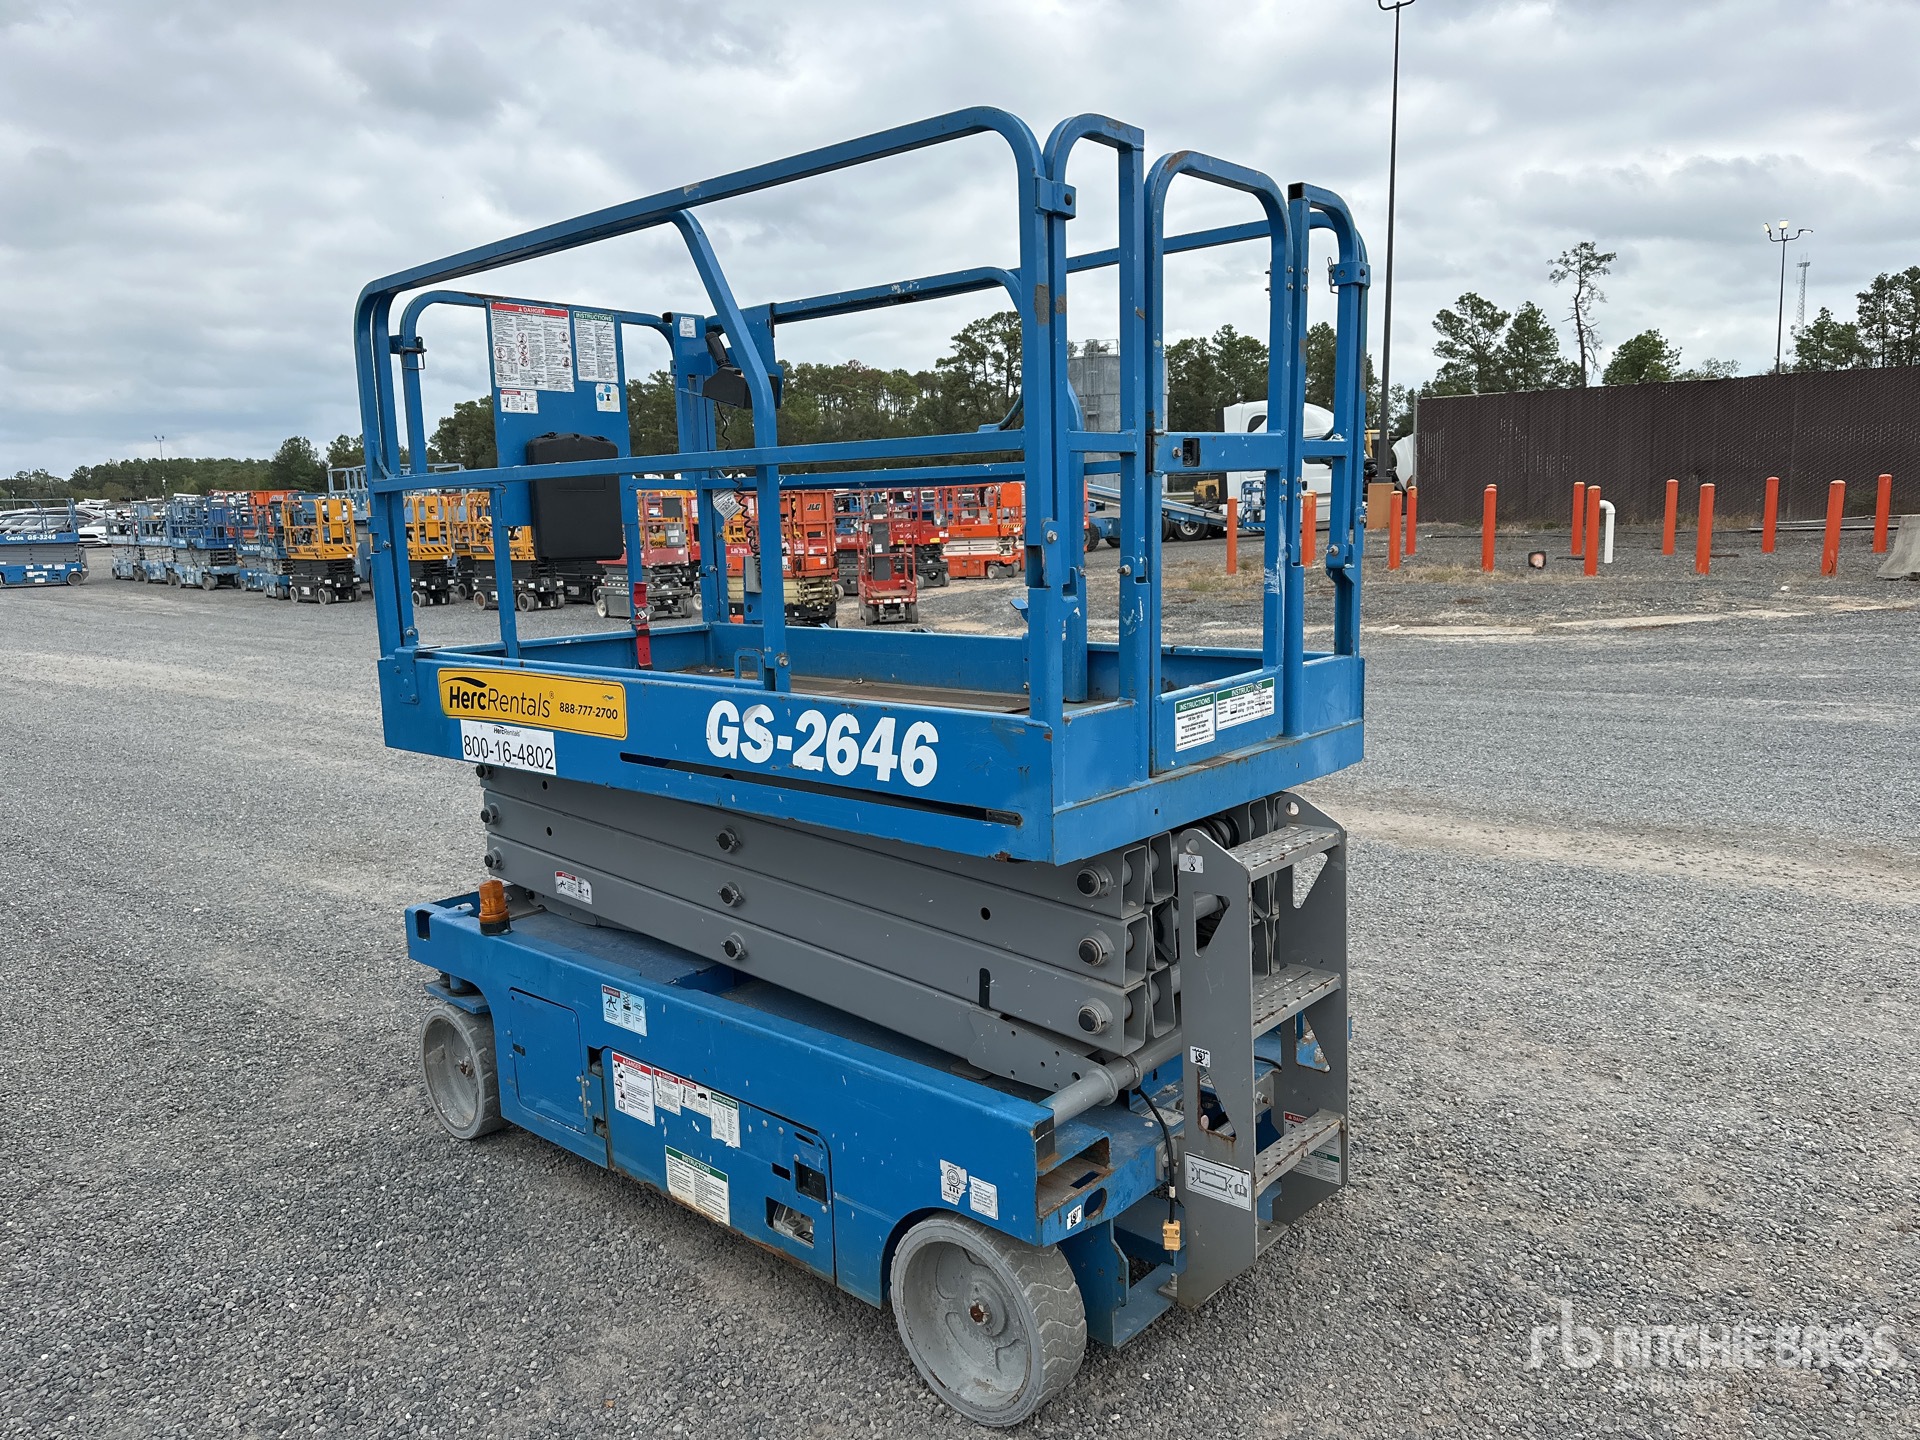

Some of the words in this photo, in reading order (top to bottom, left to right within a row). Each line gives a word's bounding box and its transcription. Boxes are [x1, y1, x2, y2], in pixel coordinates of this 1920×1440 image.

[523, 307, 546, 315] DANGER
[575, 312, 613, 322] INSTRUCTIONS
[806, 502, 821, 511] JLG
[559, 702, 619, 720] 888-777-2700
[1179, 696, 1211, 712] INSTRUCTIONS
[705, 700, 940, 787] GS-2646
[463, 734, 555, 770] 800-16-4802
[624, 1059, 642, 1071] DANGER
[681, 1155, 711, 1174] INSTRUCTIONS
